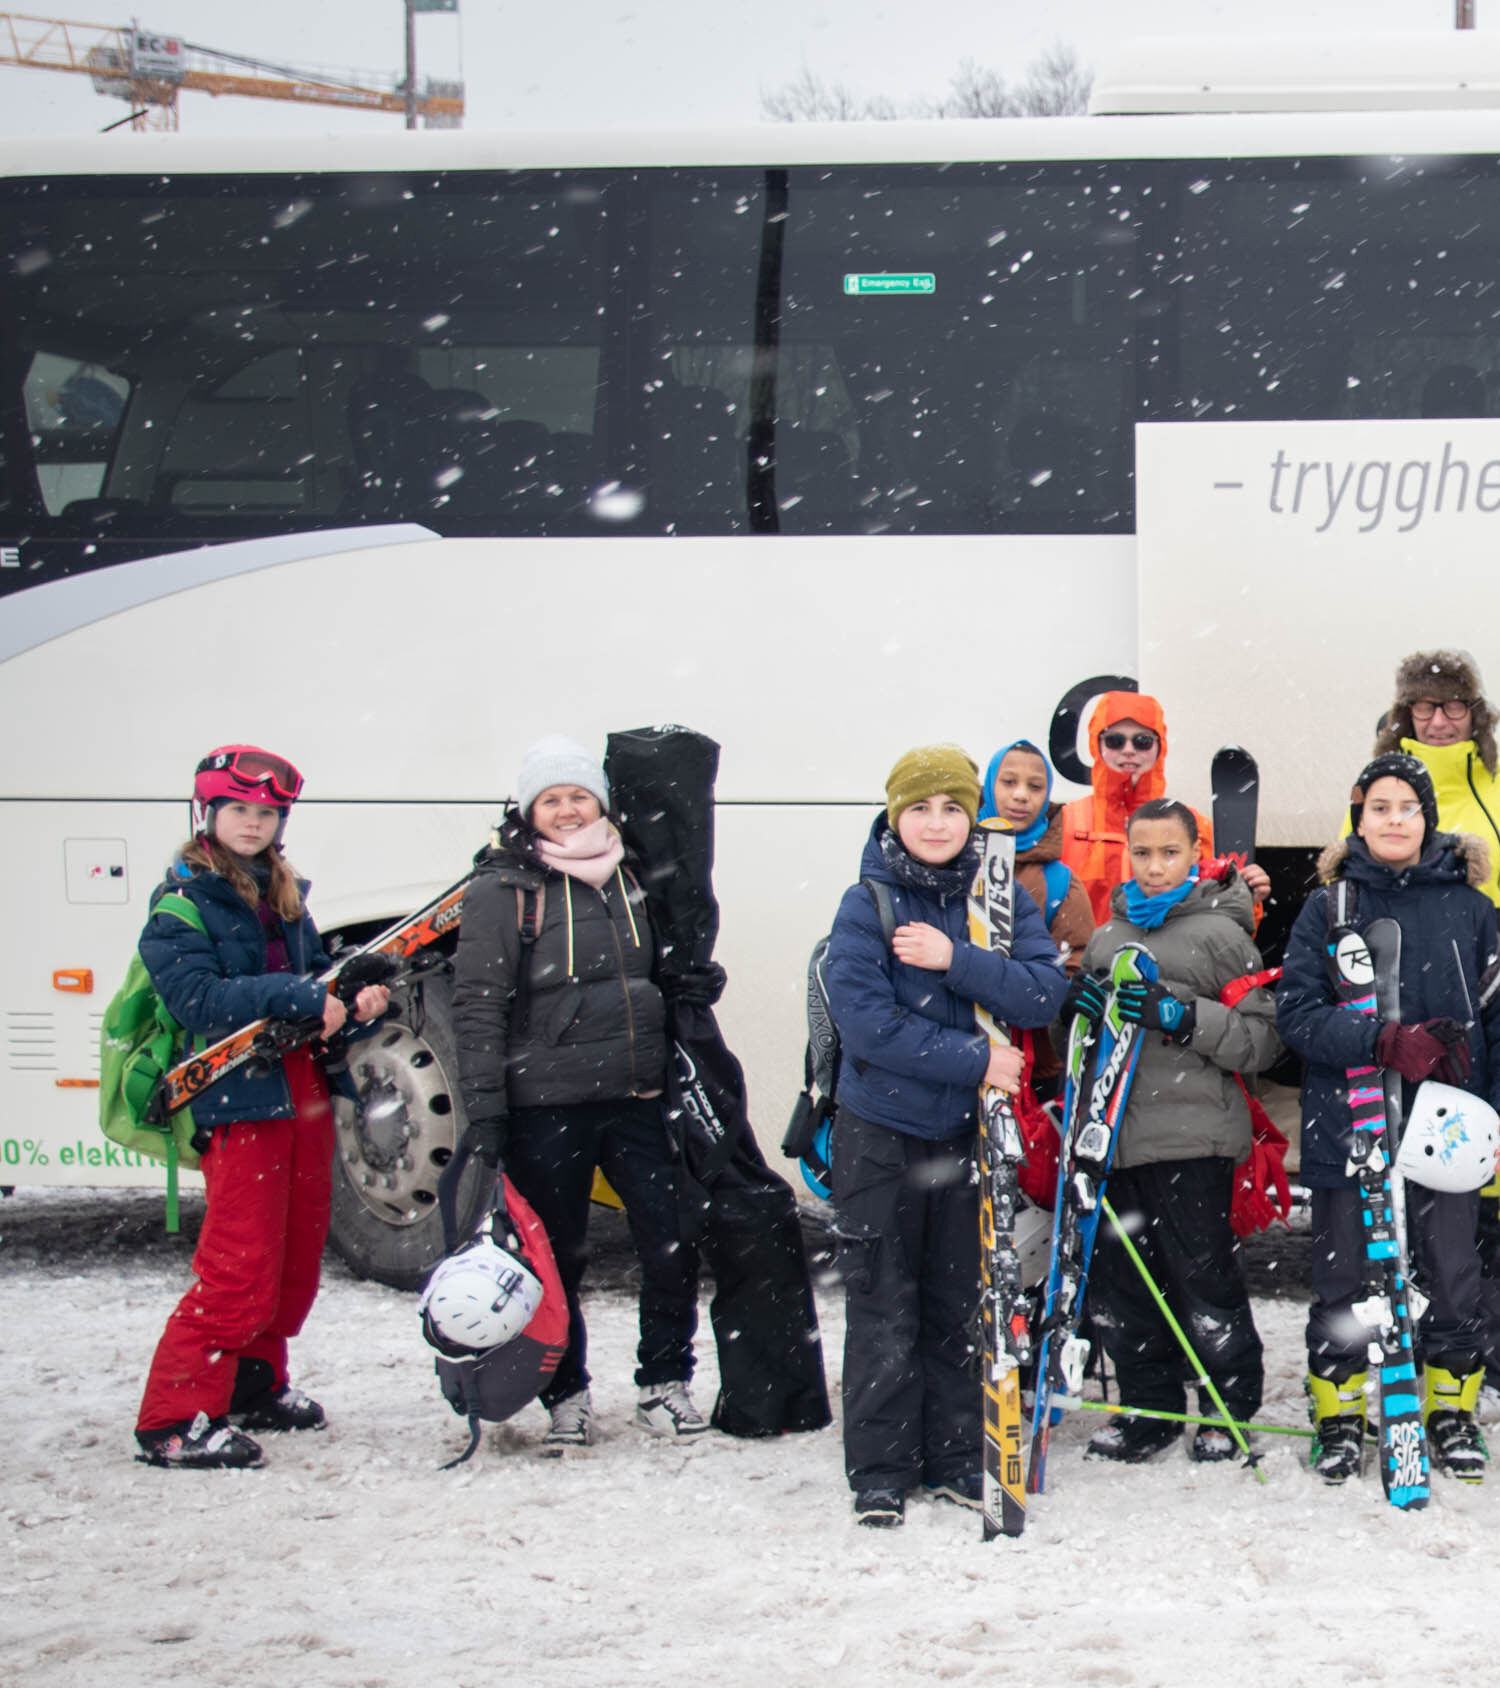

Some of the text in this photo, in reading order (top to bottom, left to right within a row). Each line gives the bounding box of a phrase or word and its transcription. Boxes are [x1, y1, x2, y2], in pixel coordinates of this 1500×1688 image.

[861, 278, 910, 289] Emergency
[0, 1138, 49, 1166] 0%
[1384, 1420, 1421, 1449] ROS
[1388, 1461, 1427, 1489] NOL
